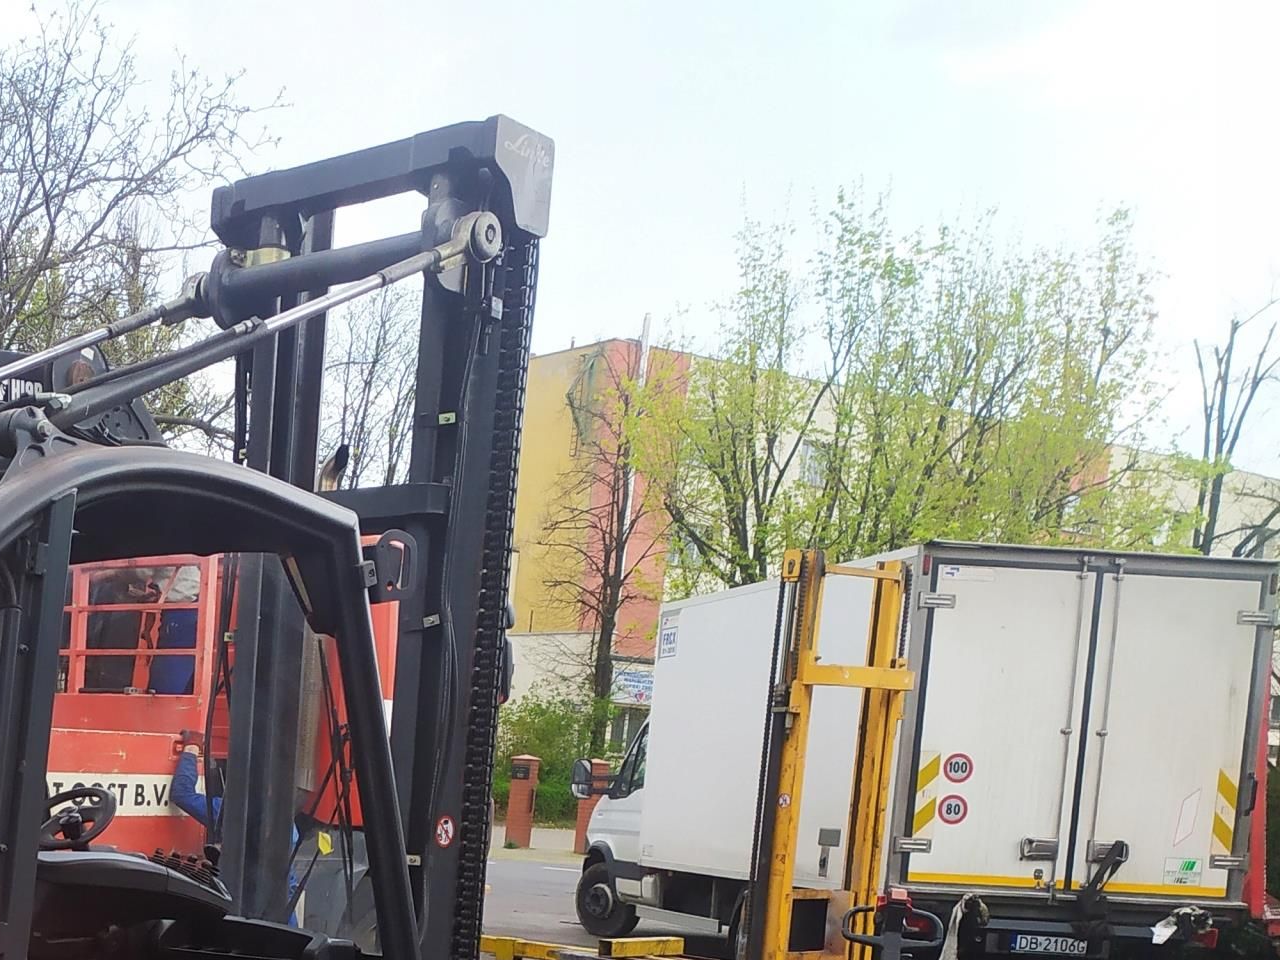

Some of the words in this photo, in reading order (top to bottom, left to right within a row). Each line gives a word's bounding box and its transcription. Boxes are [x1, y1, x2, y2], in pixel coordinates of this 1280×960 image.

[948, 761, 968, 774] 100
[133, 783, 169, 807] B.V.
[945, 803, 961, 816] 80
[1019, 935, 1039, 951] DB
[1043, 937, 1086, 953] 2106G
